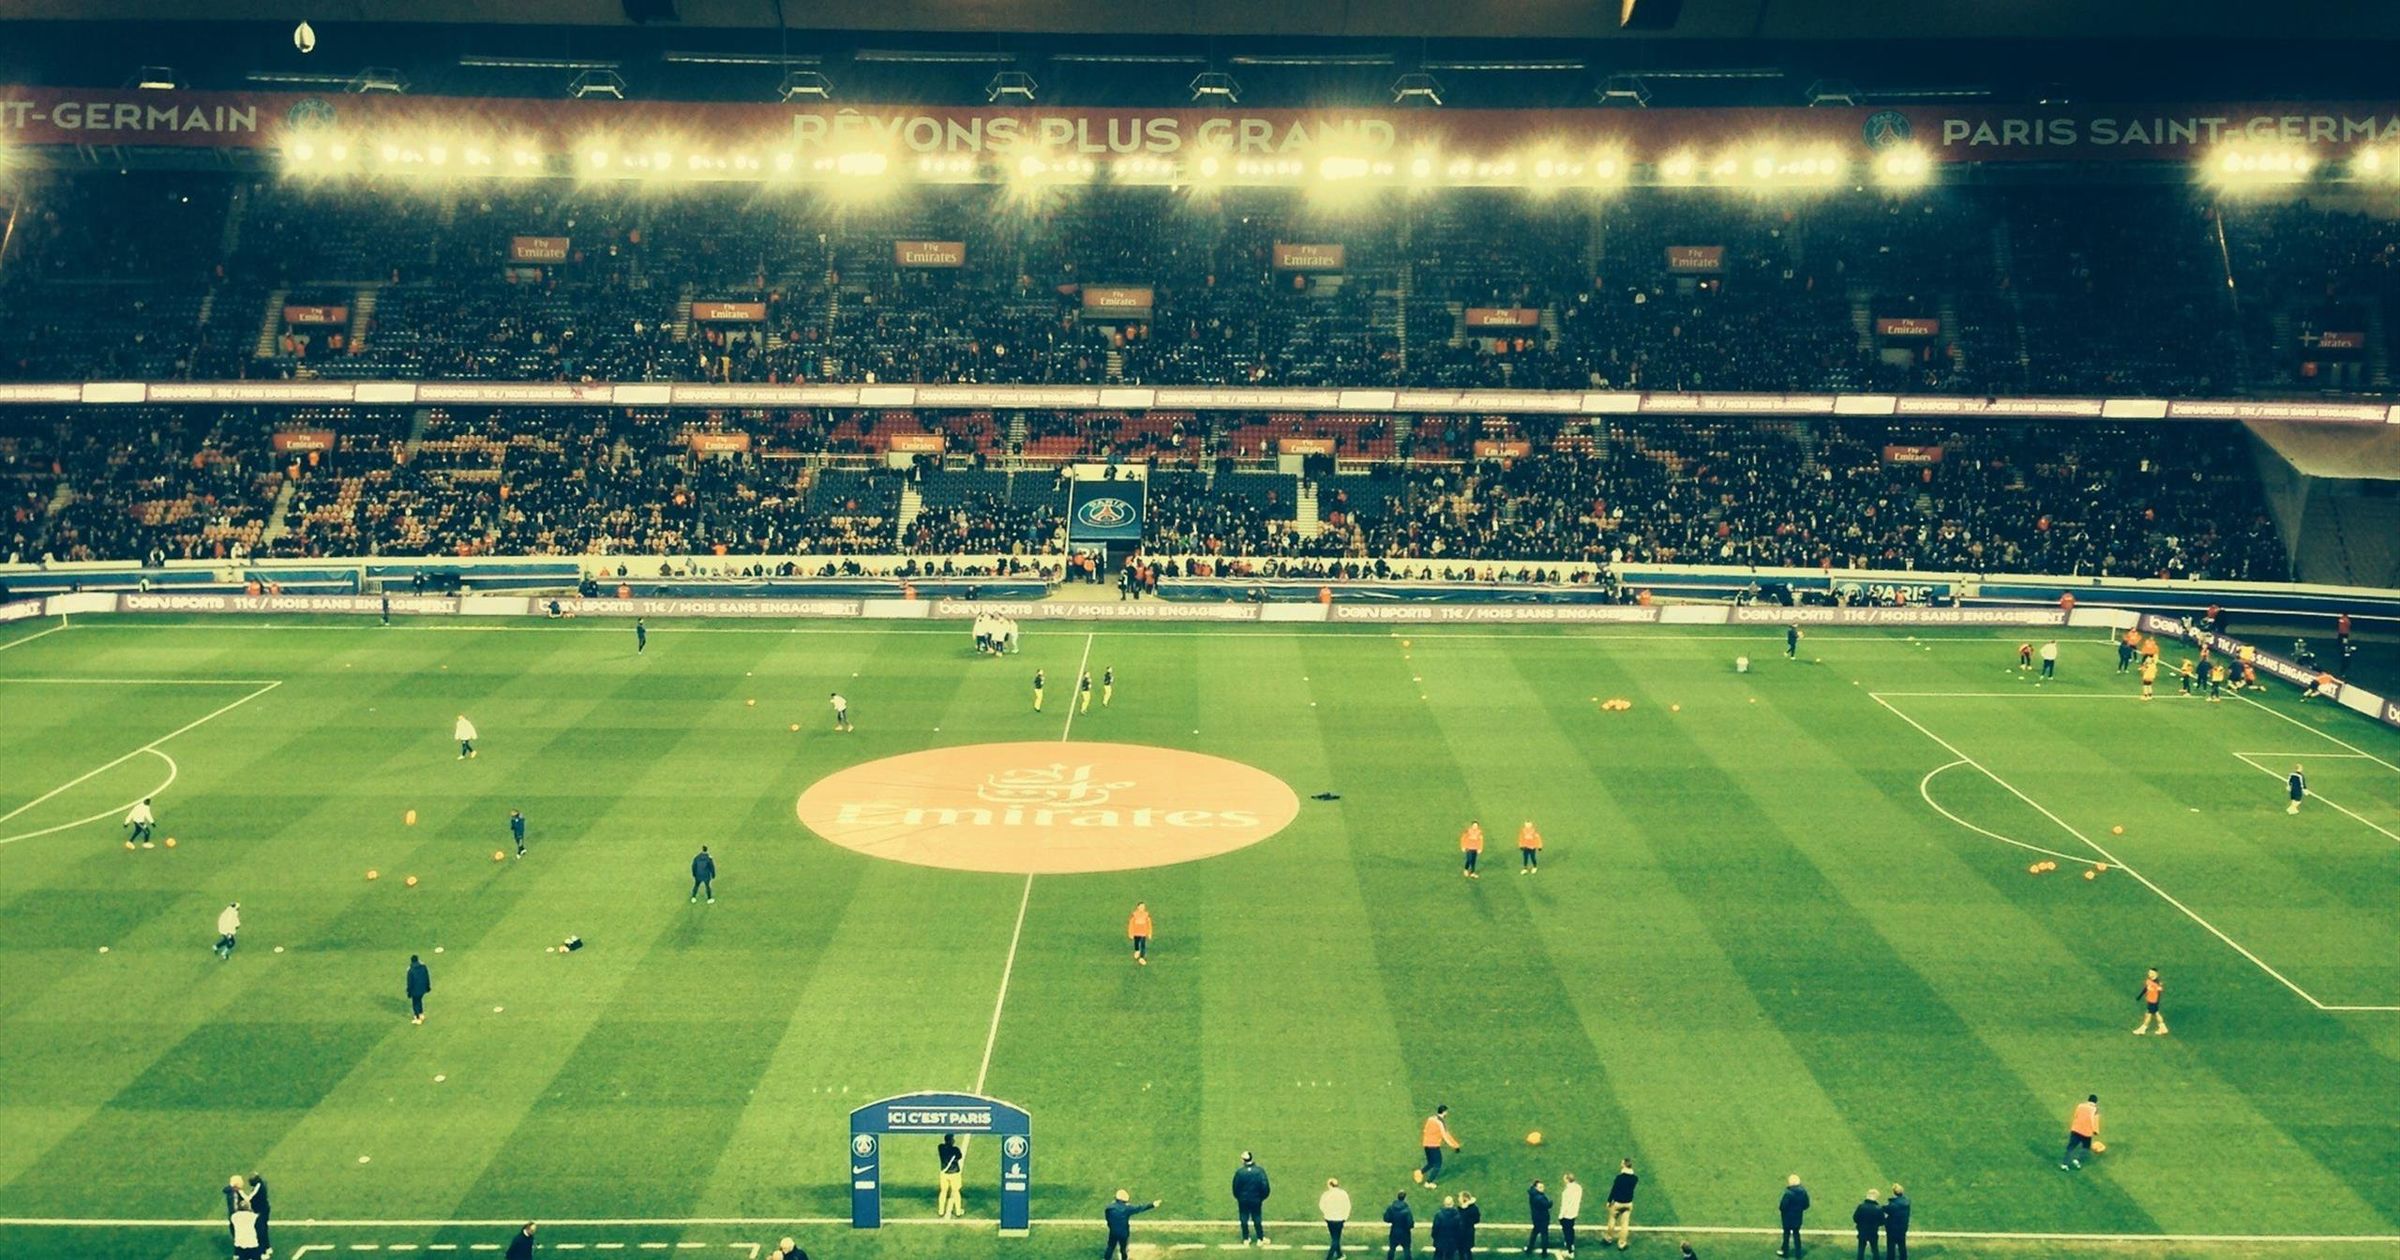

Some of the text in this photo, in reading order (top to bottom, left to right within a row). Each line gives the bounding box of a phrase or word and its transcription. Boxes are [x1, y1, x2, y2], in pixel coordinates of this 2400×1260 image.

[1037, 116, 1181, 153] PLUS
[1199, 116, 1394, 153] GRAND
[1943, 117, 2078, 146] PARIS
[534, 239, 549, 249] Fly
[923, 243, 939, 252] Fly
[517, 248, 566, 258] Emirates
[1302, 246, 1317, 255] Fly
[1688, 249, 1704, 258] Fly
[906, 252, 957, 263] Emirates
[1284, 255, 1335, 266] Emirates
[1672, 258, 1720, 267] Emirates
[1100, 298, 1137, 306] Emirates
[711, 311, 749, 319] Emirates
[1888, 326, 1928, 335] Emirates
[171, 598, 225, 609] SPORTS
[272, 599, 308, 610] MOIS
[312, 599, 346, 610] SANS
[355, 599, 457, 613] ENGAGENT
[583, 602, 634, 612] SPORTS
[680, 602, 716, 613] MOIS
[719, 603, 757, 613] SANS
[760, 603, 859, 616] ENGAGENT
[982, 604, 1033, 615] SPORTS
[1078, 605, 1114, 616] MOIS
[1118, 605, 1155, 616] SANS
[1159, 605, 1257, 619] ENGAGENT
[1381, 607, 1431, 618] SPORTS
[1477, 608, 1513, 619] MOIS
[1516, 608, 1555, 619] SANS
[1558, 608, 1657, 622] ENGAGENT
[1781, 610, 1834, 621] SPORTS
[1880, 610, 1917, 621] MOIS
[1920, 611, 1959, 622] SANS
[1962, 611, 2065, 624] ENGAGENT
[2256, 653, 2279, 672] SANS
[835, 803, 1261, 829] Emirates
[888, 1112, 992, 1125] ICI C'EST PARIS
